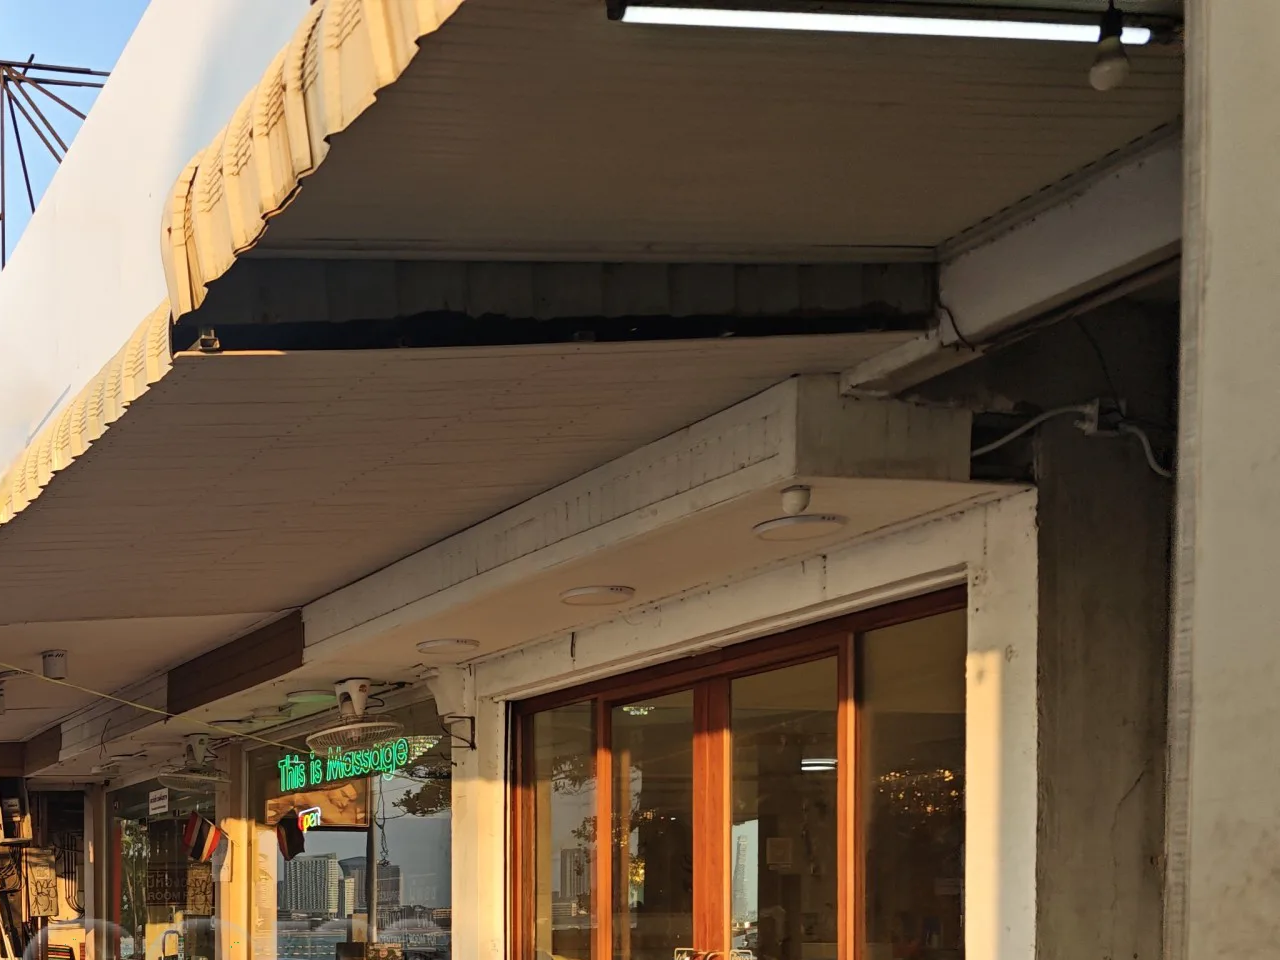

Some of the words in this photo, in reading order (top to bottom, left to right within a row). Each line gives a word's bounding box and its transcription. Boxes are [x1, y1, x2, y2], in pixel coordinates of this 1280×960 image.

[278, 755, 305, 791] This
[310, 750, 322, 785] is
[326, 738, 408, 780] Massage
